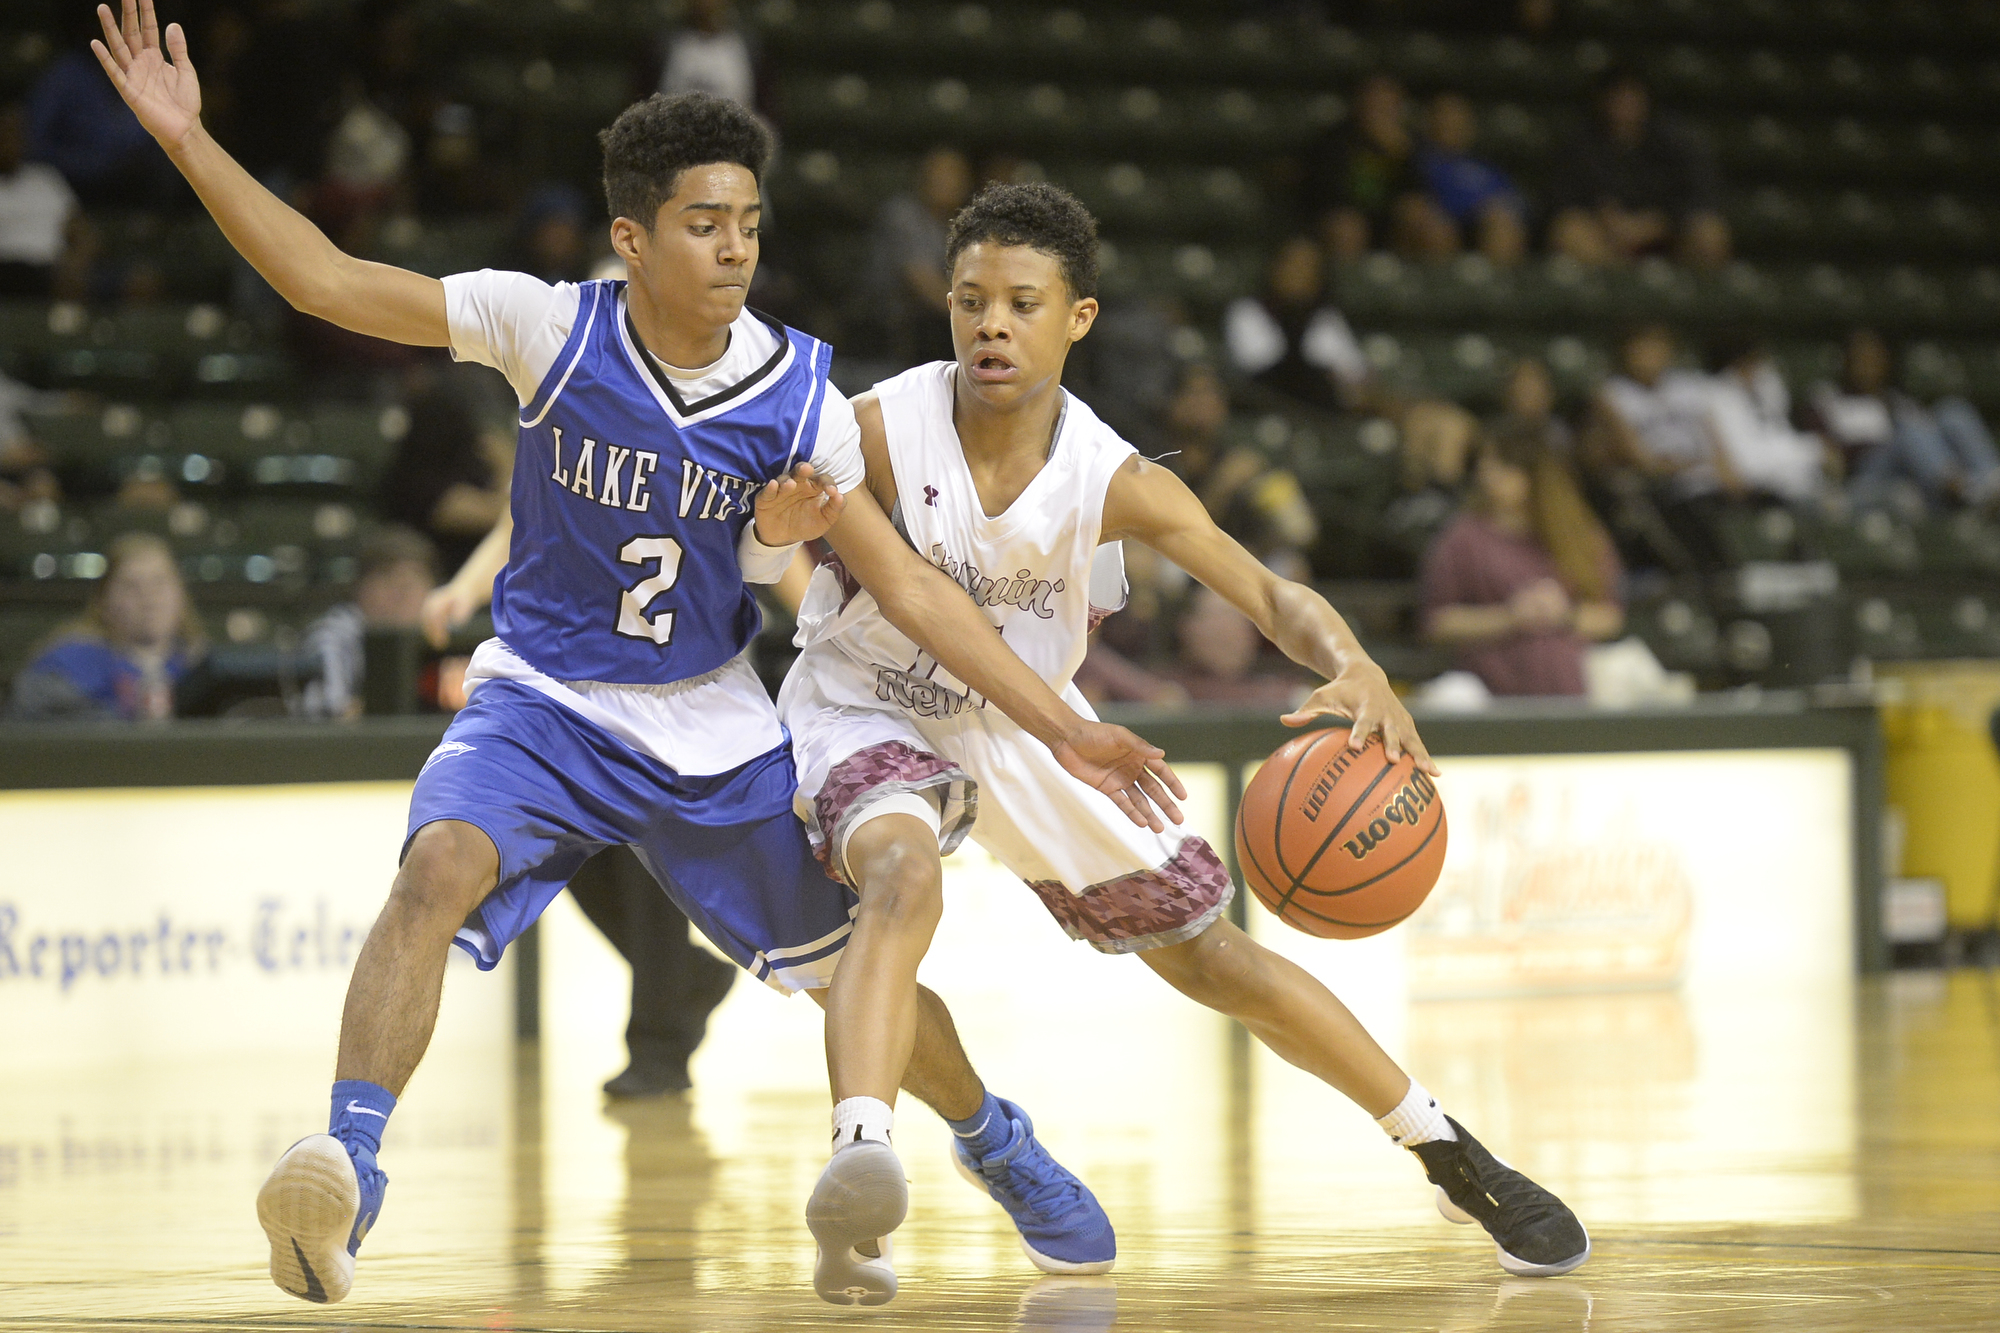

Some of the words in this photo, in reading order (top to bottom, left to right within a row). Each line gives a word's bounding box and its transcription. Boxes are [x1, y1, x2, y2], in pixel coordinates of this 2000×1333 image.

[551, 426, 657, 513] LAKE
[612, 533, 687, 646] 2
[1342, 766, 1437, 861] Wilson
[0, 899, 364, 994] Reporter-Tele
